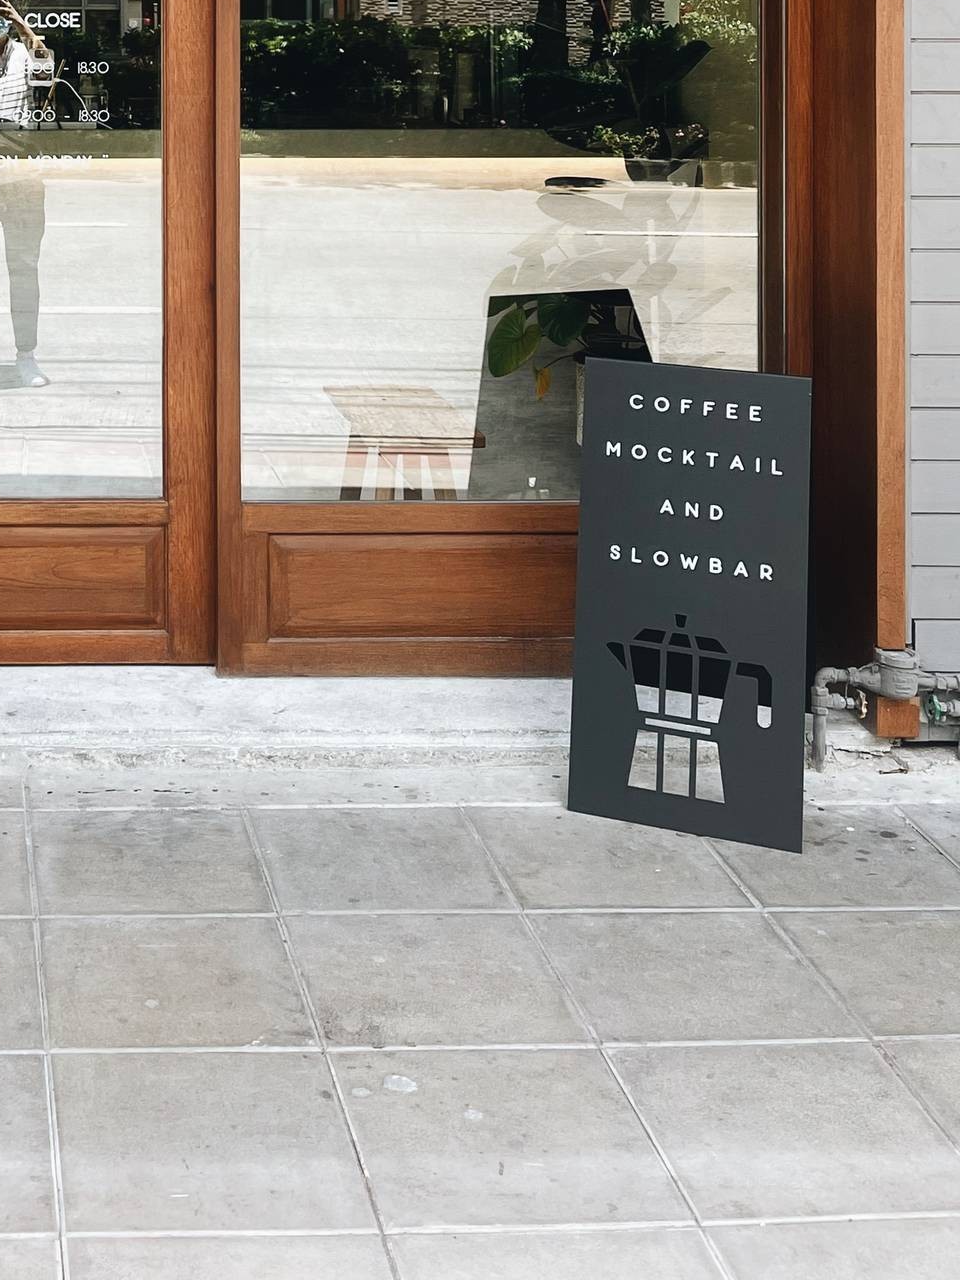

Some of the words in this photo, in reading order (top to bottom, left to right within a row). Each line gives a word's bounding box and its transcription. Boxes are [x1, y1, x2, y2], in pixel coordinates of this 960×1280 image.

[25, 13, 81, 28] CLOSE
[628, 394, 763, 422] COFFEE
[605, 440, 784, 476] MOCKTAIL
[659, 499, 724, 521] AND
[609, 544, 774, 581] SLOWBAR
